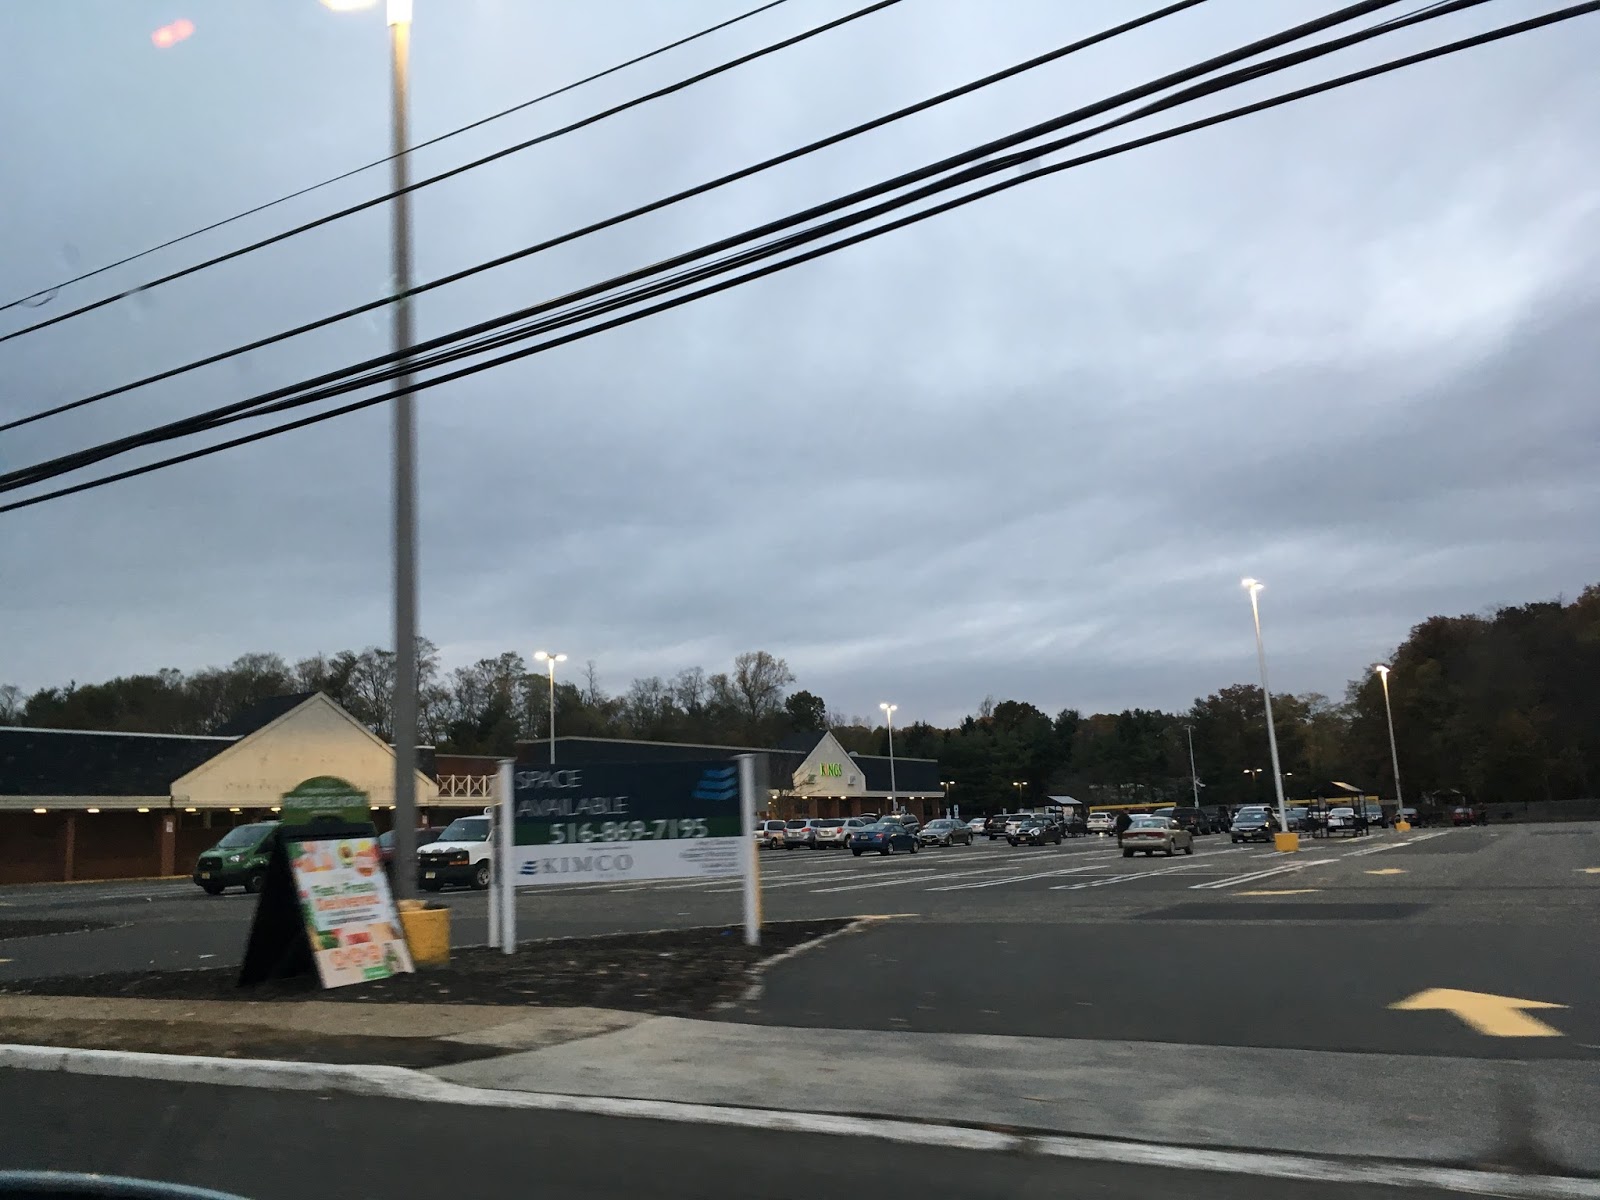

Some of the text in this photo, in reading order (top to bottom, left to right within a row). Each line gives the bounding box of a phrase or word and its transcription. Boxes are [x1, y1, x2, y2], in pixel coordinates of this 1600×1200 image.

[515, 769, 582, 789] SPACE
[820, 762, 842, 776] KINGS
[515, 796, 629, 817] AVAILABLE
[550, 818, 709, 844] 516-869-7195
[540, 854, 634, 874] KIMCO
